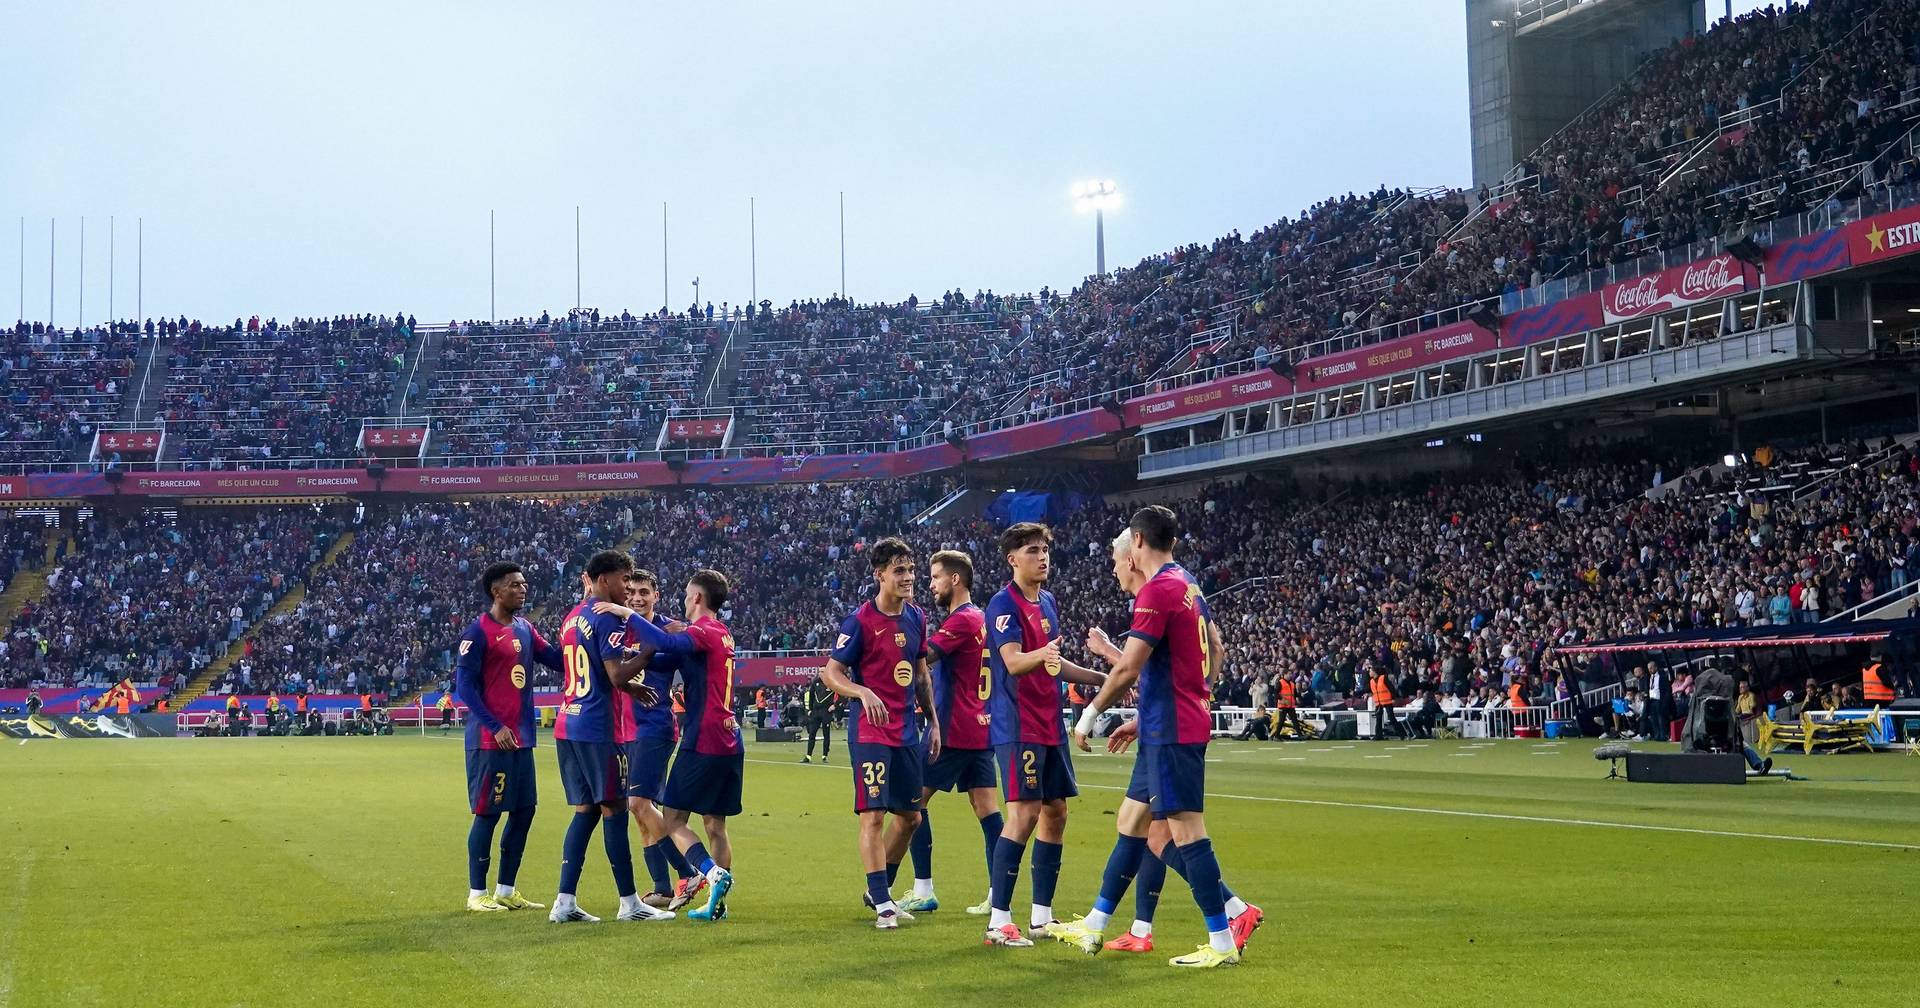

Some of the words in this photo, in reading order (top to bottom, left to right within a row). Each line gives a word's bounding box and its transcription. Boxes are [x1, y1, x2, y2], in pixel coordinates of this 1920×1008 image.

[1433, 340, 1441, 351] FC
[1441, 332, 1474, 349] BARCELONA
[1398, 347, 1413, 359] CLUB
[1322, 367, 1328, 377] FC
[1328, 361, 1357, 376] BARCELONA
[1245, 380, 1273, 393] BARCELONA
[234, 479, 249, 487] QUE
[514, 475, 529, 483] QUE
[598, 472, 639, 480] BARCELONA
[1198, 615, 1210, 679] 9
[563, 644, 591, 698] 19
[785, 667, 794, 676] FC
[978, 648, 991, 701] 5
[616, 754, 629, 777] 19
[1022, 750, 1037, 774] 2
[862, 761, 886, 785] 32
[494, 772, 506, 794] 3
